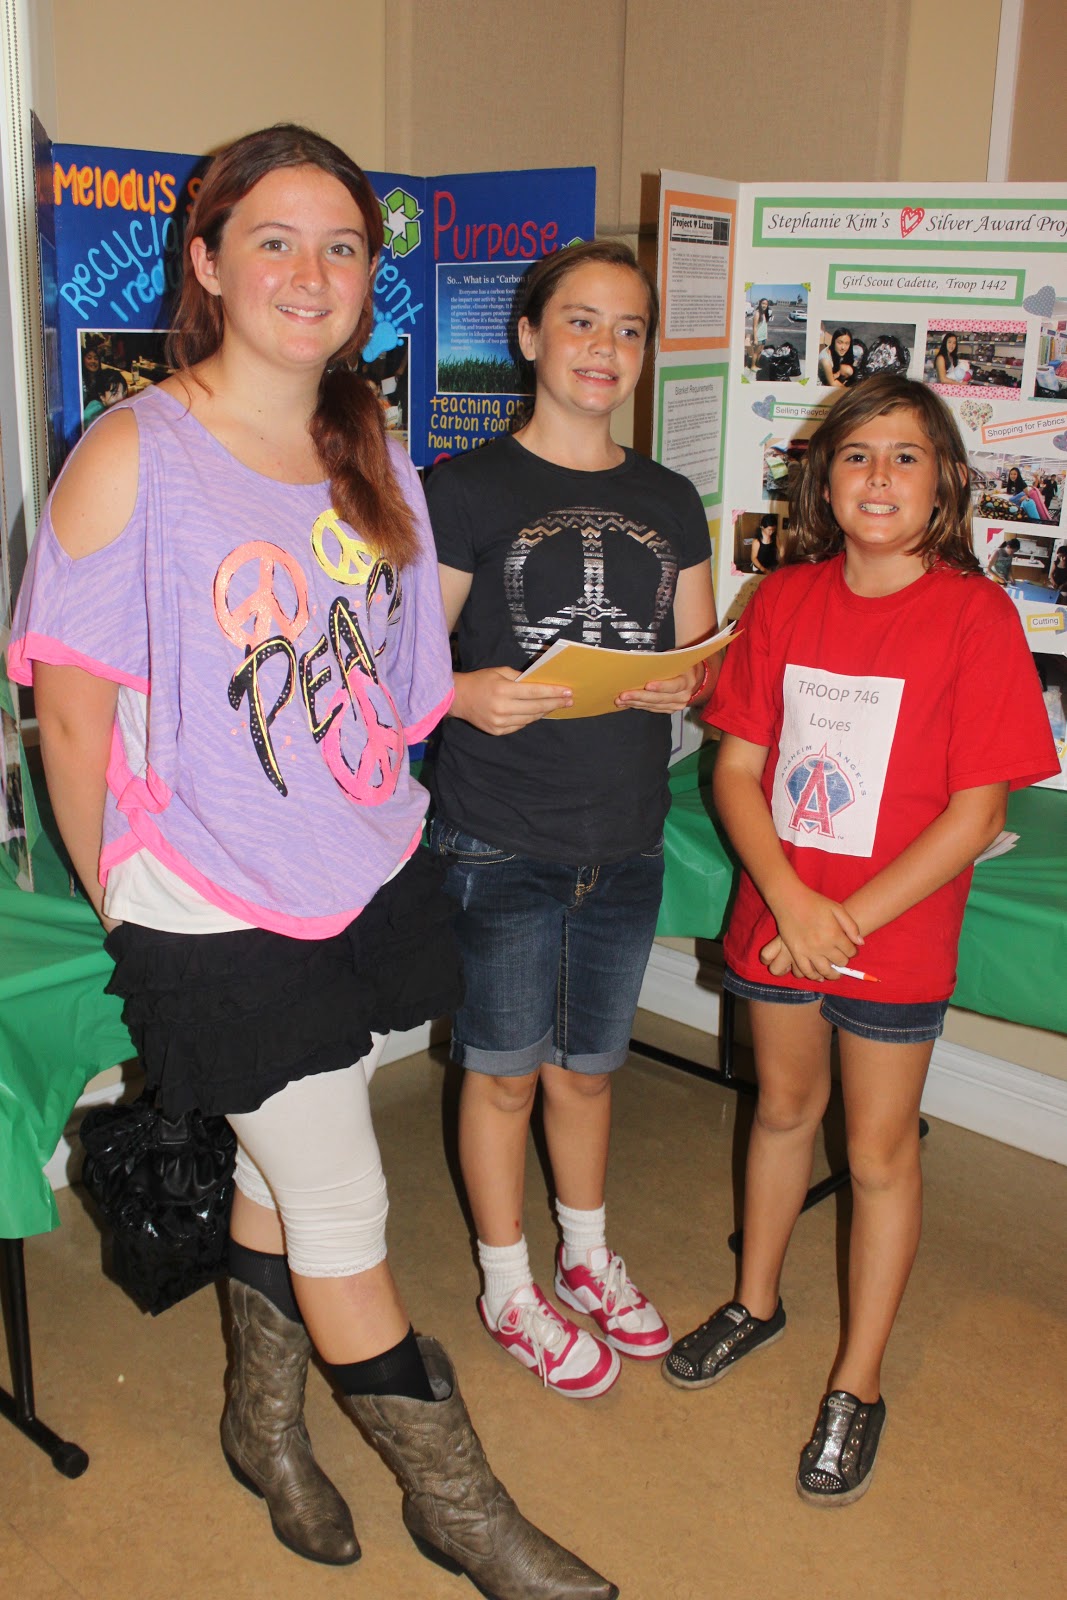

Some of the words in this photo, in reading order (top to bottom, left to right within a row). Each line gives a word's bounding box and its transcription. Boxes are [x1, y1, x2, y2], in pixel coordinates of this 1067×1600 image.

[54, 162, 177, 215] Melody's
[433, 190, 559, 261] Purpose
[672, 217, 693, 229] Project
[698, 219, 713, 230] Linus
[768, 211, 841, 233] Stephanie
[845, 212, 890, 231] Kim's
[925, 213, 973, 232] Silver
[973, 213, 1036, 233] Award
[1036, 216, 1067, 237] Proj
[373, 255, 424, 325] ent
[447, 276, 462, 285] So...
[463, 275, 482, 284] What
[483, 275, 490, 284] is
[842, 274, 865, 290] Girl
[864, 276, 894, 288] Scout
[896, 276, 939, 290] Cadette,
[945, 277, 977, 293] Troop
[980, 280, 1007, 291] 1442
[430, 396, 501, 418] teaching
[775, 406, 799, 416] Selling
[801, 407, 830, 416] Recycla
[483, 416, 511, 432] foot
[987, 425, 1023, 438] Shopping
[1024, 422, 1035, 431] for
[1036, 417, 1066, 429] Fabrics
[428, 431, 453, 449] how
[454, 434, 468, 450] to
[1032, 617, 1059, 626] Cutting
[228, 557, 403, 798] PEAC
[798, 680, 850, 703] TROOP
[853, 690, 880, 705] 746
[809, 712, 852, 732] Loves
[780, 745, 812, 778] ANAHEIM
[836, 751, 867, 797] ANGELS
